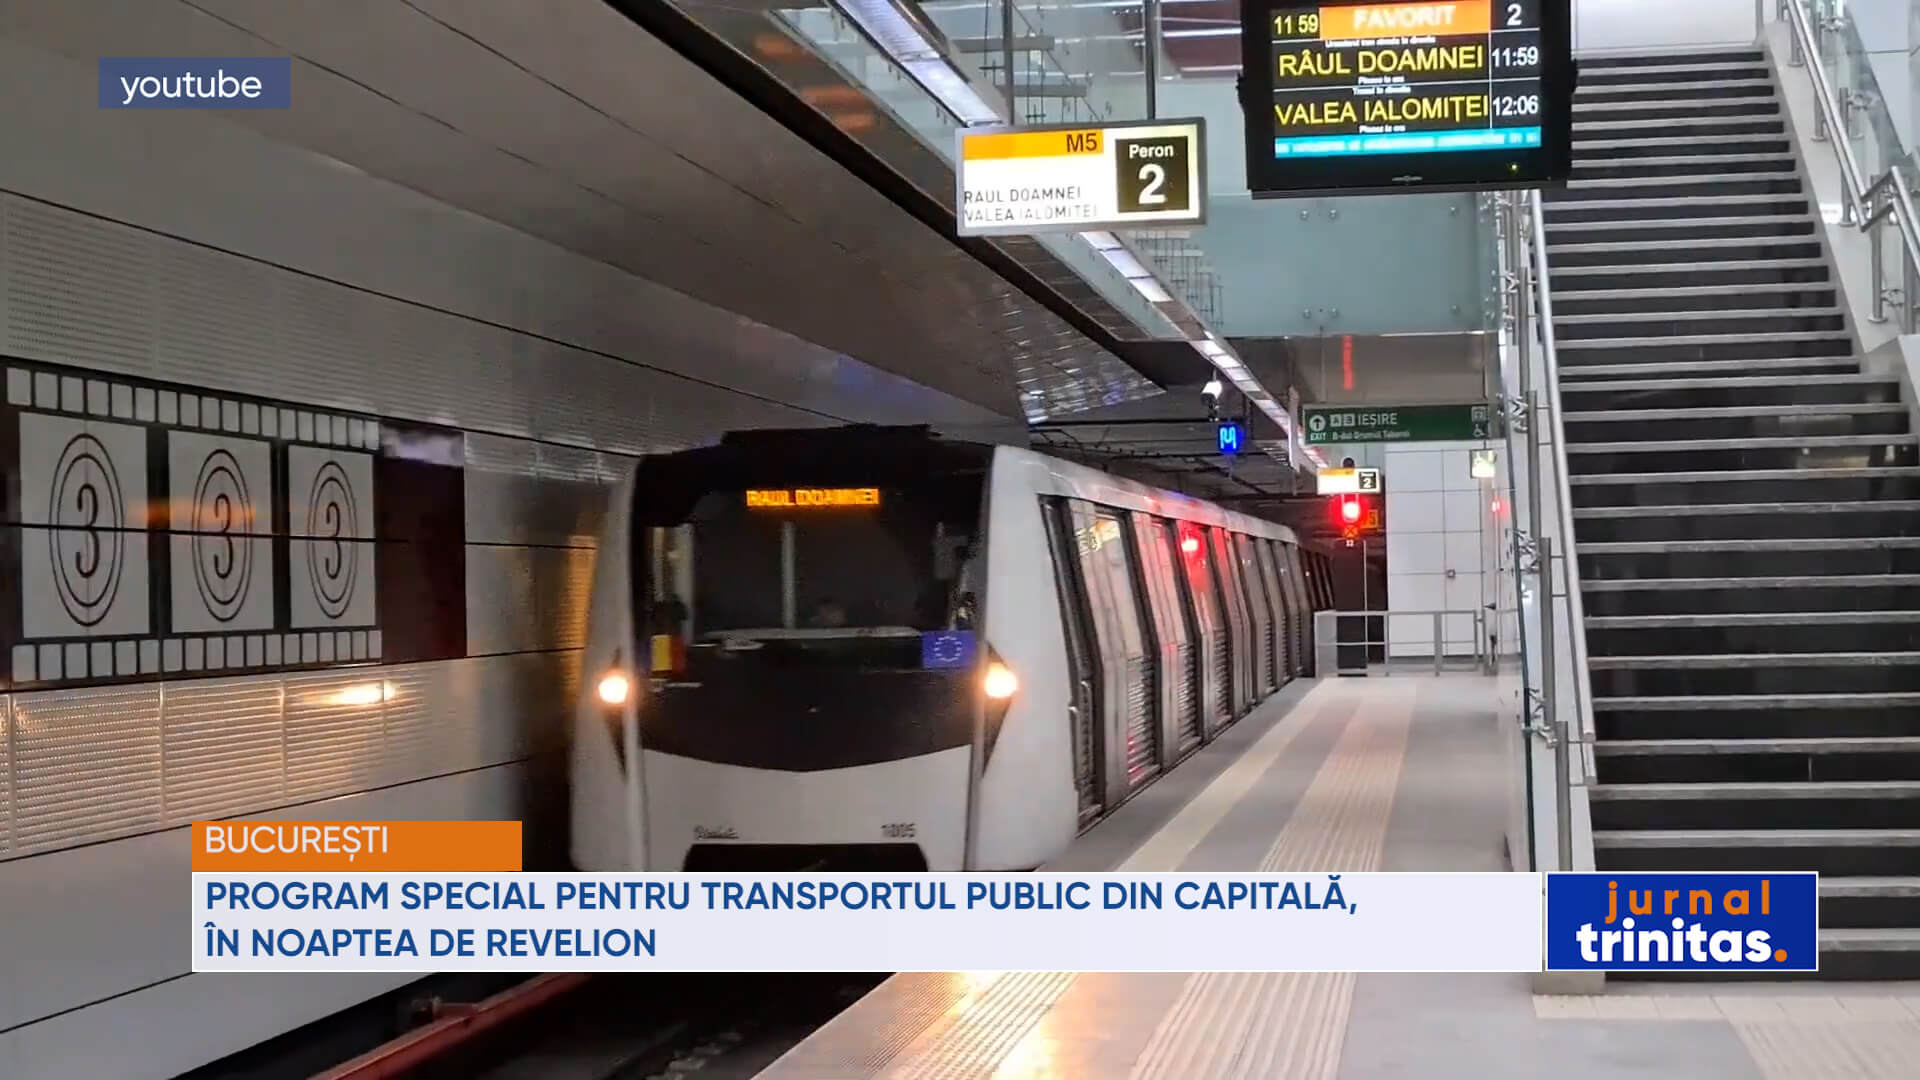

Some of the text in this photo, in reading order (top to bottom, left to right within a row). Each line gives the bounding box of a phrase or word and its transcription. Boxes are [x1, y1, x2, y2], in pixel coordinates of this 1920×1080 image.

[1354, 5, 1457, 29] FAVORIT
[1507, 4, 1522, 26] 2
[1279, 46, 1483, 77] RÂUL DOAMNEI
[1491, 46, 1538, 67] 11:59
[1275, 102, 1357, 126] VALEA
[1492, 95, 1538, 116] 12:06
[1066, 133, 1097, 152] M5
[1129, 143, 1174, 159] Peron
[1138, 163, 1166, 204] 2
[964, 186, 1081, 204] RAUL DOAMNEI
[964, 207, 1015, 222] VALEA
[1363, 477, 1372, 488] 2
[76, 483, 99, 578] 3
[214, 493, 233, 579] 3
[325, 502, 341, 579] 3
